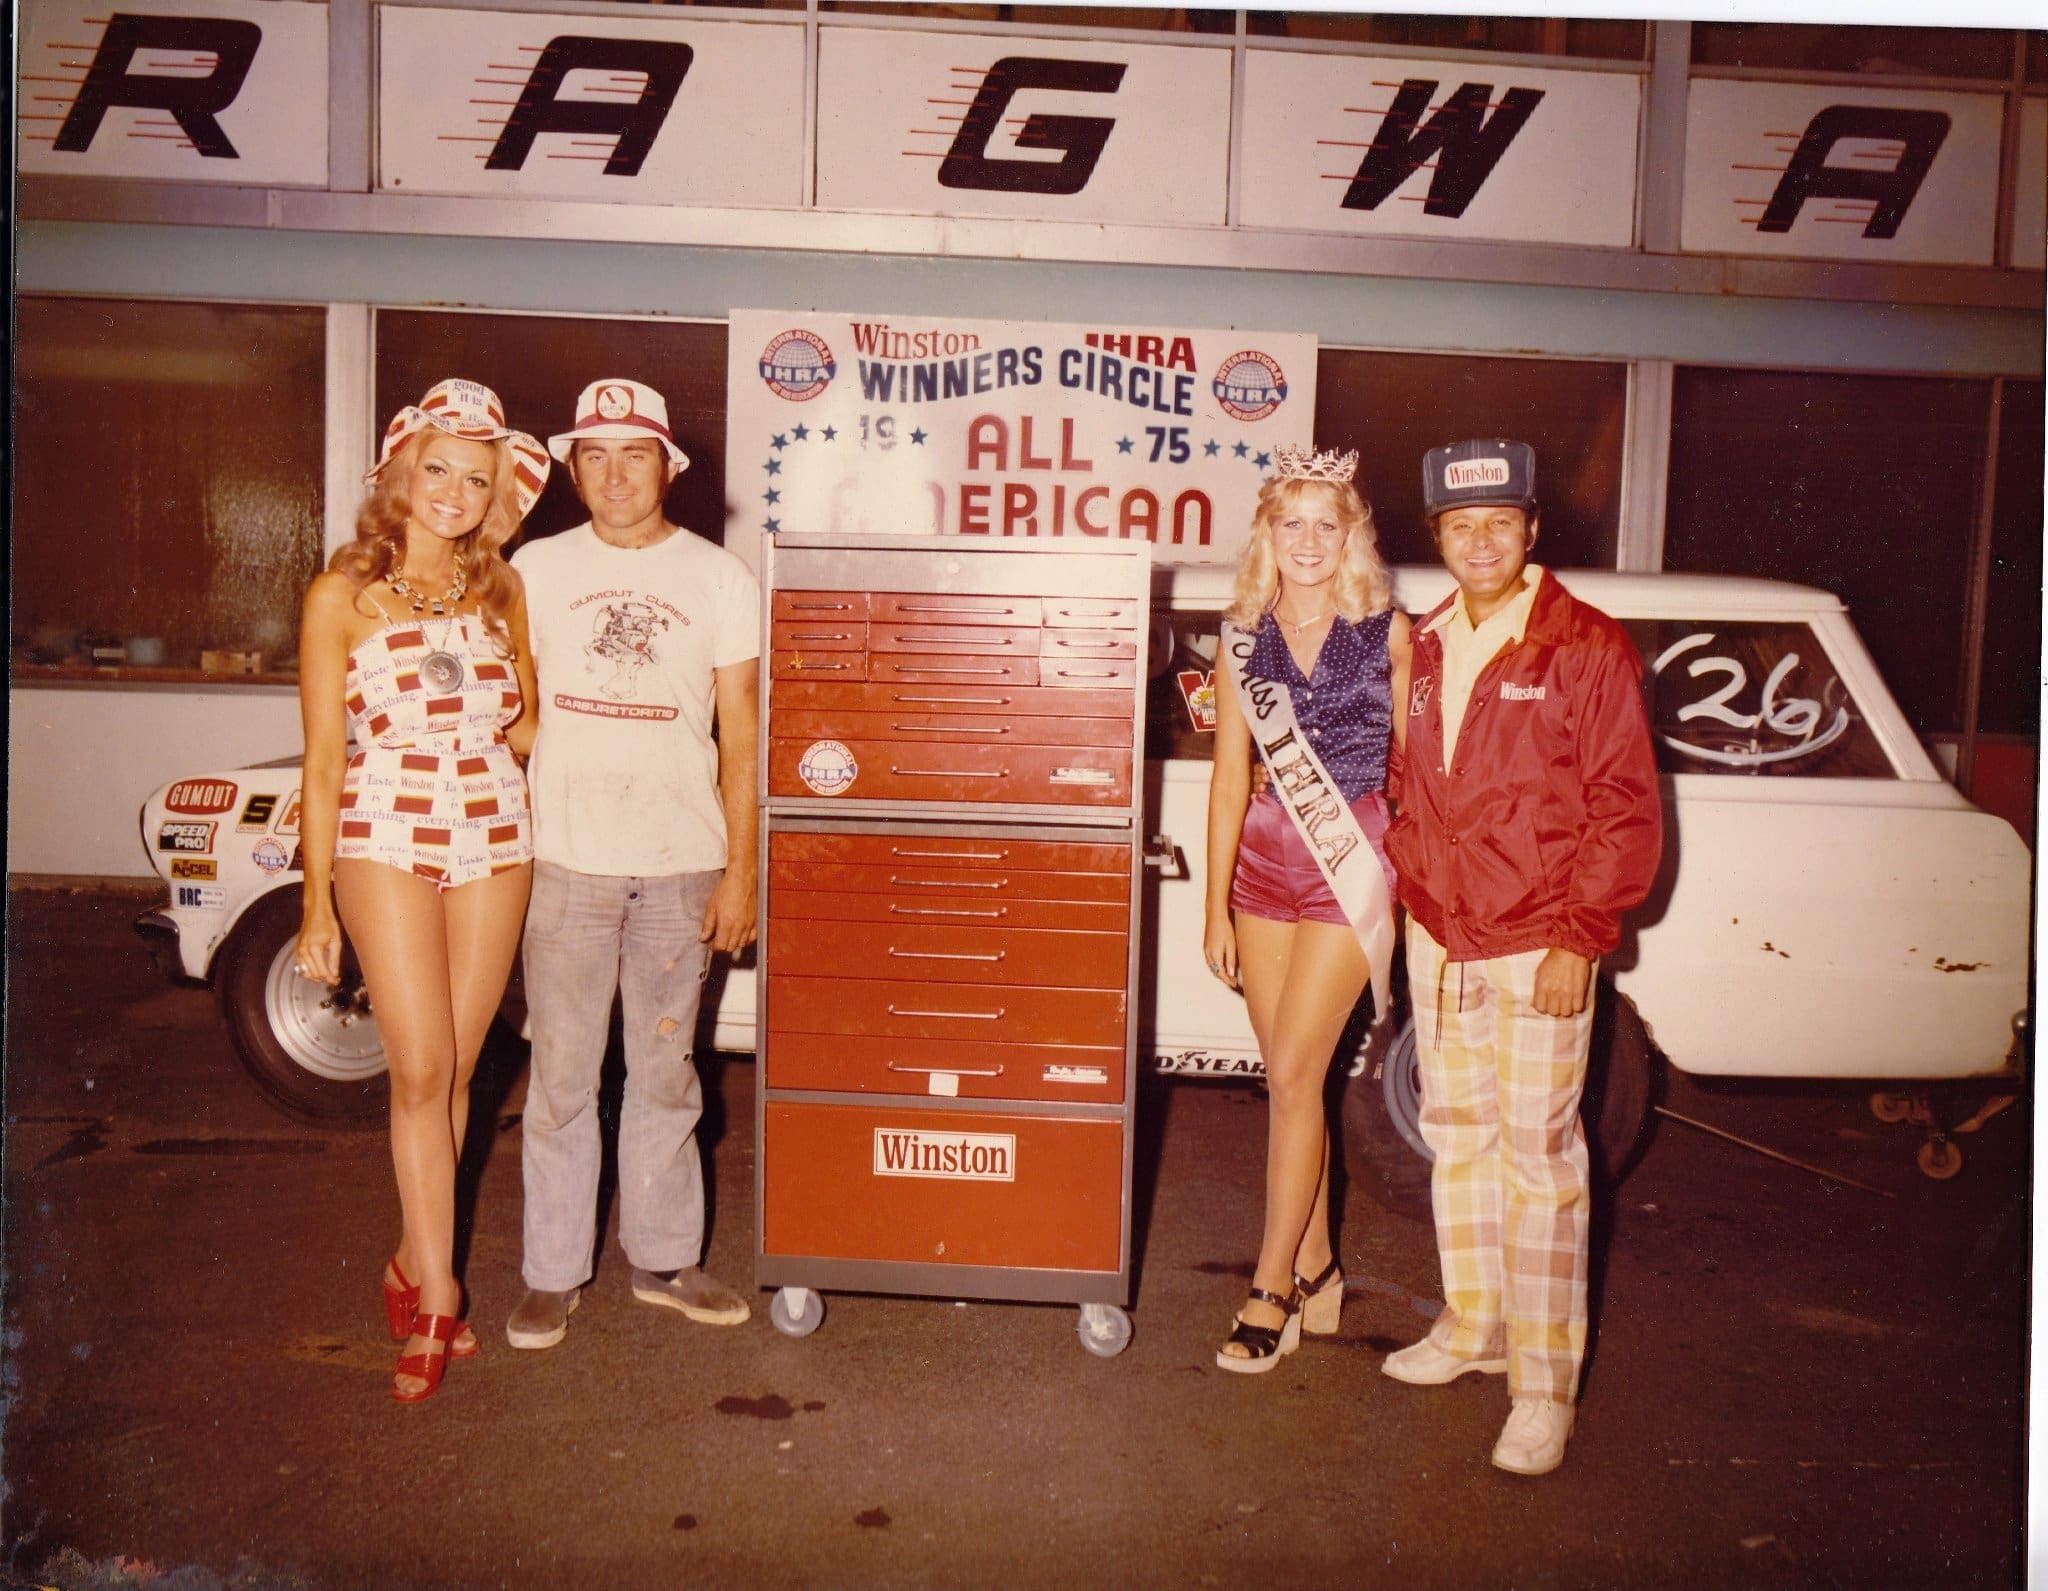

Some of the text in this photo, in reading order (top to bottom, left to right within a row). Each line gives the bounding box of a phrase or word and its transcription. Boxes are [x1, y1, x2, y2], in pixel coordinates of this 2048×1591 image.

[850, 322, 982, 360] Winston
[1085, 333, 1197, 373] IHRA
[764, 365, 832, 381] IHRA
[857, 346, 1195, 417] WINNERS CIRCLE
[453, 380, 485, 395] good
[1215, 384, 1283, 402] IHRA
[859, 414, 897, 451] 19
[965, 414, 1094, 472] ALL
[1145, 426, 1191, 464] 75
[1449, 463, 1504, 485] Winston
[569, 589, 691, 627] GUMOUT CURES
[392, 654, 427, 671] Winsto
[1501, 681, 1546, 700] Winston
[1677, 652, 1822, 737] 26
[556, 696, 675, 719] CARBURETORITIS
[400, 775, 436, 792] Winston
[803, 766, 854, 780] IHRA
[170, 784, 234, 808] GUMOUT
[1263, 727, 1359, 877] IHRA
[161, 823, 209, 837] SPEED
[174, 836, 206, 849] PRO
[173, 863, 215, 878] ACCEL
[882, 1134, 1008, 1174] Winston
